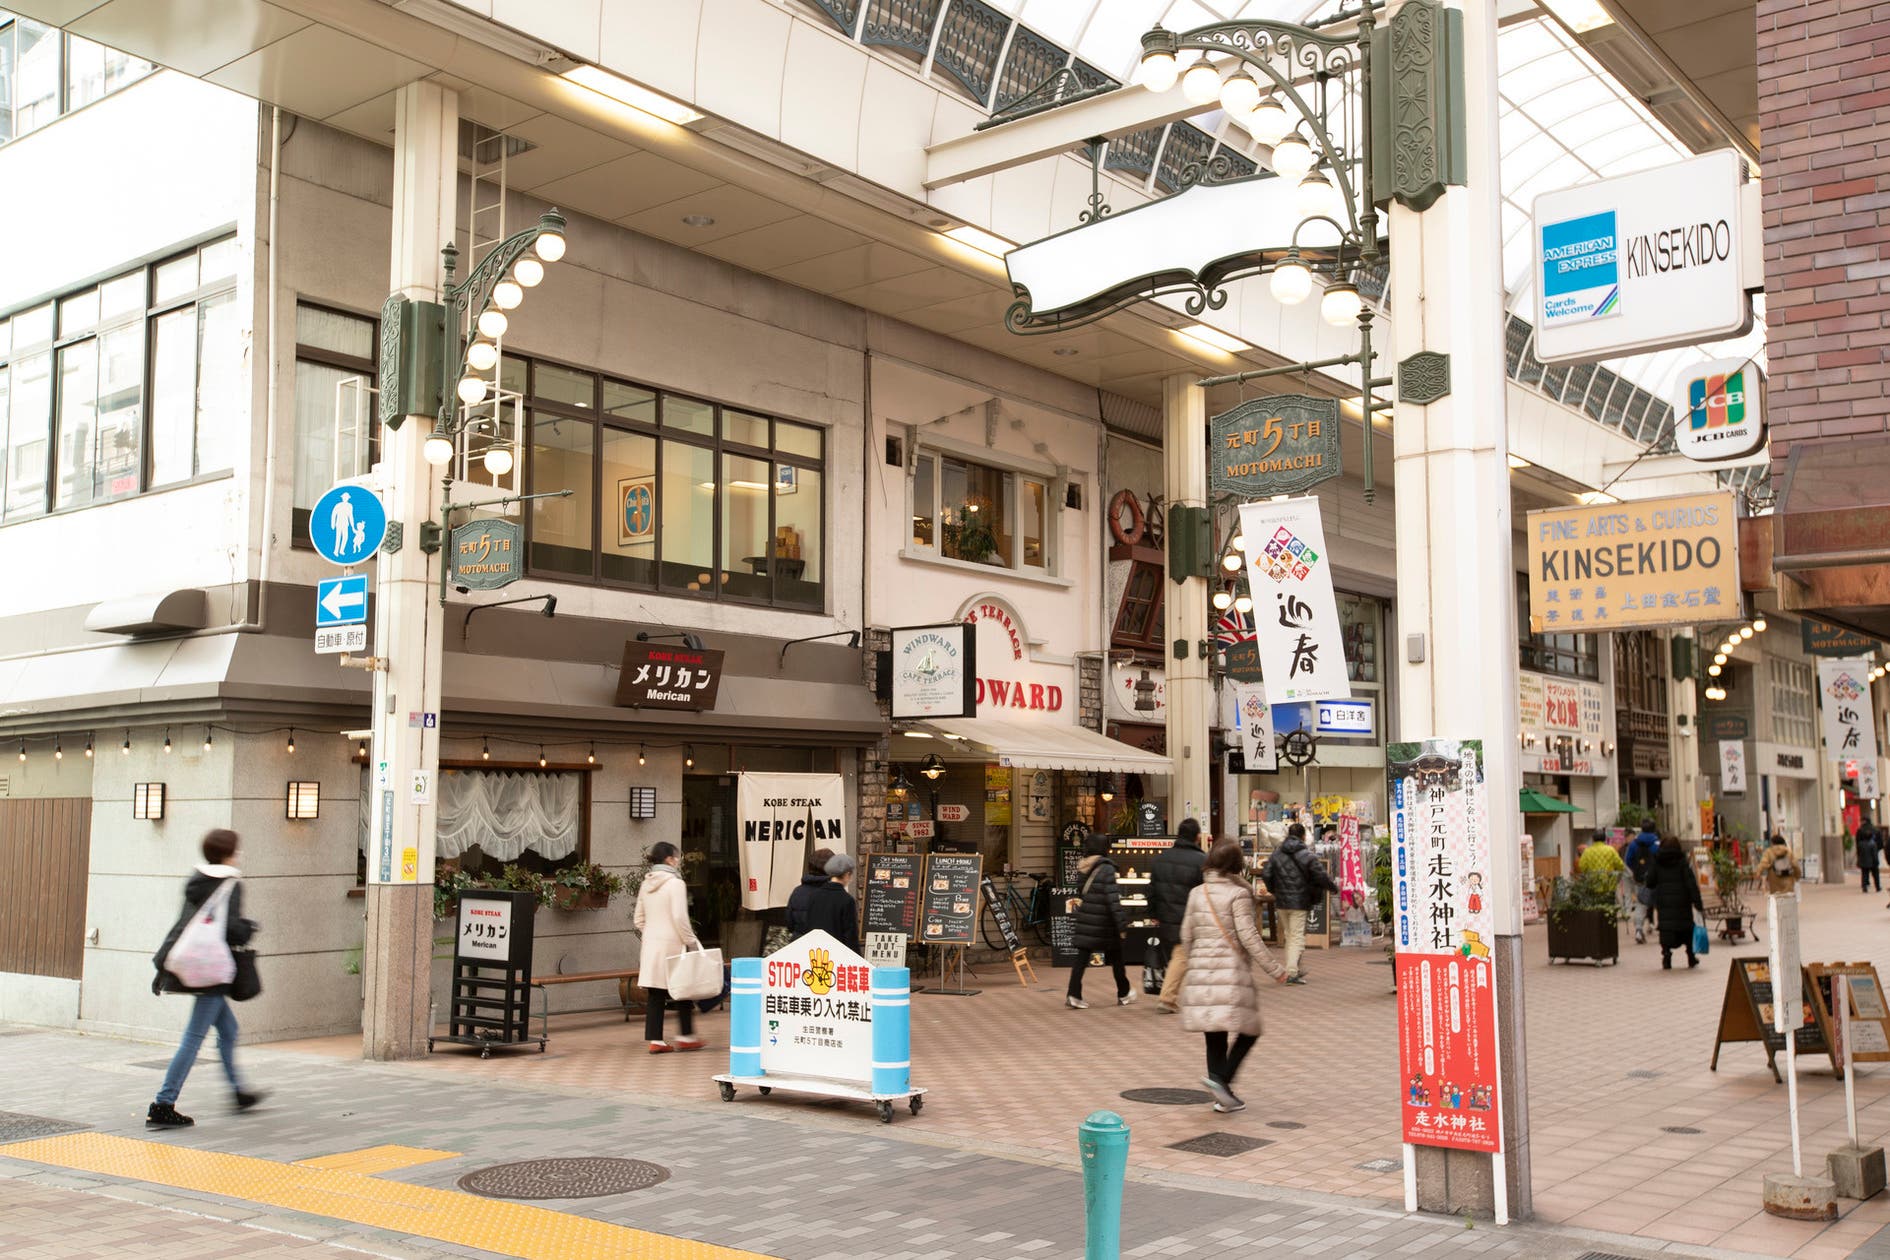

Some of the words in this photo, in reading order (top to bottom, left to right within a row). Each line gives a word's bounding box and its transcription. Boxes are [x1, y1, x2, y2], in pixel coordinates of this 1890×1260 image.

[1544, 235, 1613, 262] AMERICAN
[1627, 219, 1730, 279] KINSEKIDO
[1558, 249, 1617, 274] EXPRESS
[1545, 297, 1576, 310] Cards
[1545, 303, 1595, 318] Welcome
[1690, 390, 1744, 411] JCB
[1226, 417, 1321, 458] 元町5丁目
[1691, 432, 1724, 443] JCB
[1726, 429, 1747, 438] CARDS
[1226, 454, 1323, 478] MOTOMACHI
[1539, 520, 1578, 542] FINE
[1586, 513, 1629, 537] ARTS
[1635, 517, 1647, 531] &
[1652, 505, 1719, 531] CURIOS
[460, 534, 511, 563] 元町5丁目
[1541, 536, 1721, 582] KINSEKIDO
[459, 563, 510, 575] MOTOMACHI
[980, 604, 1022, 661] TERRACE
[1276, 592, 1319, 680] 迎春
[903, 633, 957, 657] WINDWARD
[648, 651, 673, 661] KOBE
[674, 653, 703, 664] STEAK
[632, 664, 711, 690] メリカン
[646, 689, 691, 702] Merican
[763, 798, 788, 807] KOBE
[790, 798, 822, 807] STEAK
[1340, 816, 1355, 892] リフォーム
[463, 923, 507, 939] メリカン
[874, 934, 899, 943] TAKE
[472, 940, 497, 949] Merican
[872, 950, 899, 958] MENU
[876, 942, 896, 950] OUT
[768, 961, 801, 988] STOP
[836, 963, 870, 994] 自転車
[766, 994, 872, 1023] 自転車乗り入れ禁止
[1415, 1110, 1487, 1132] 走水神社
